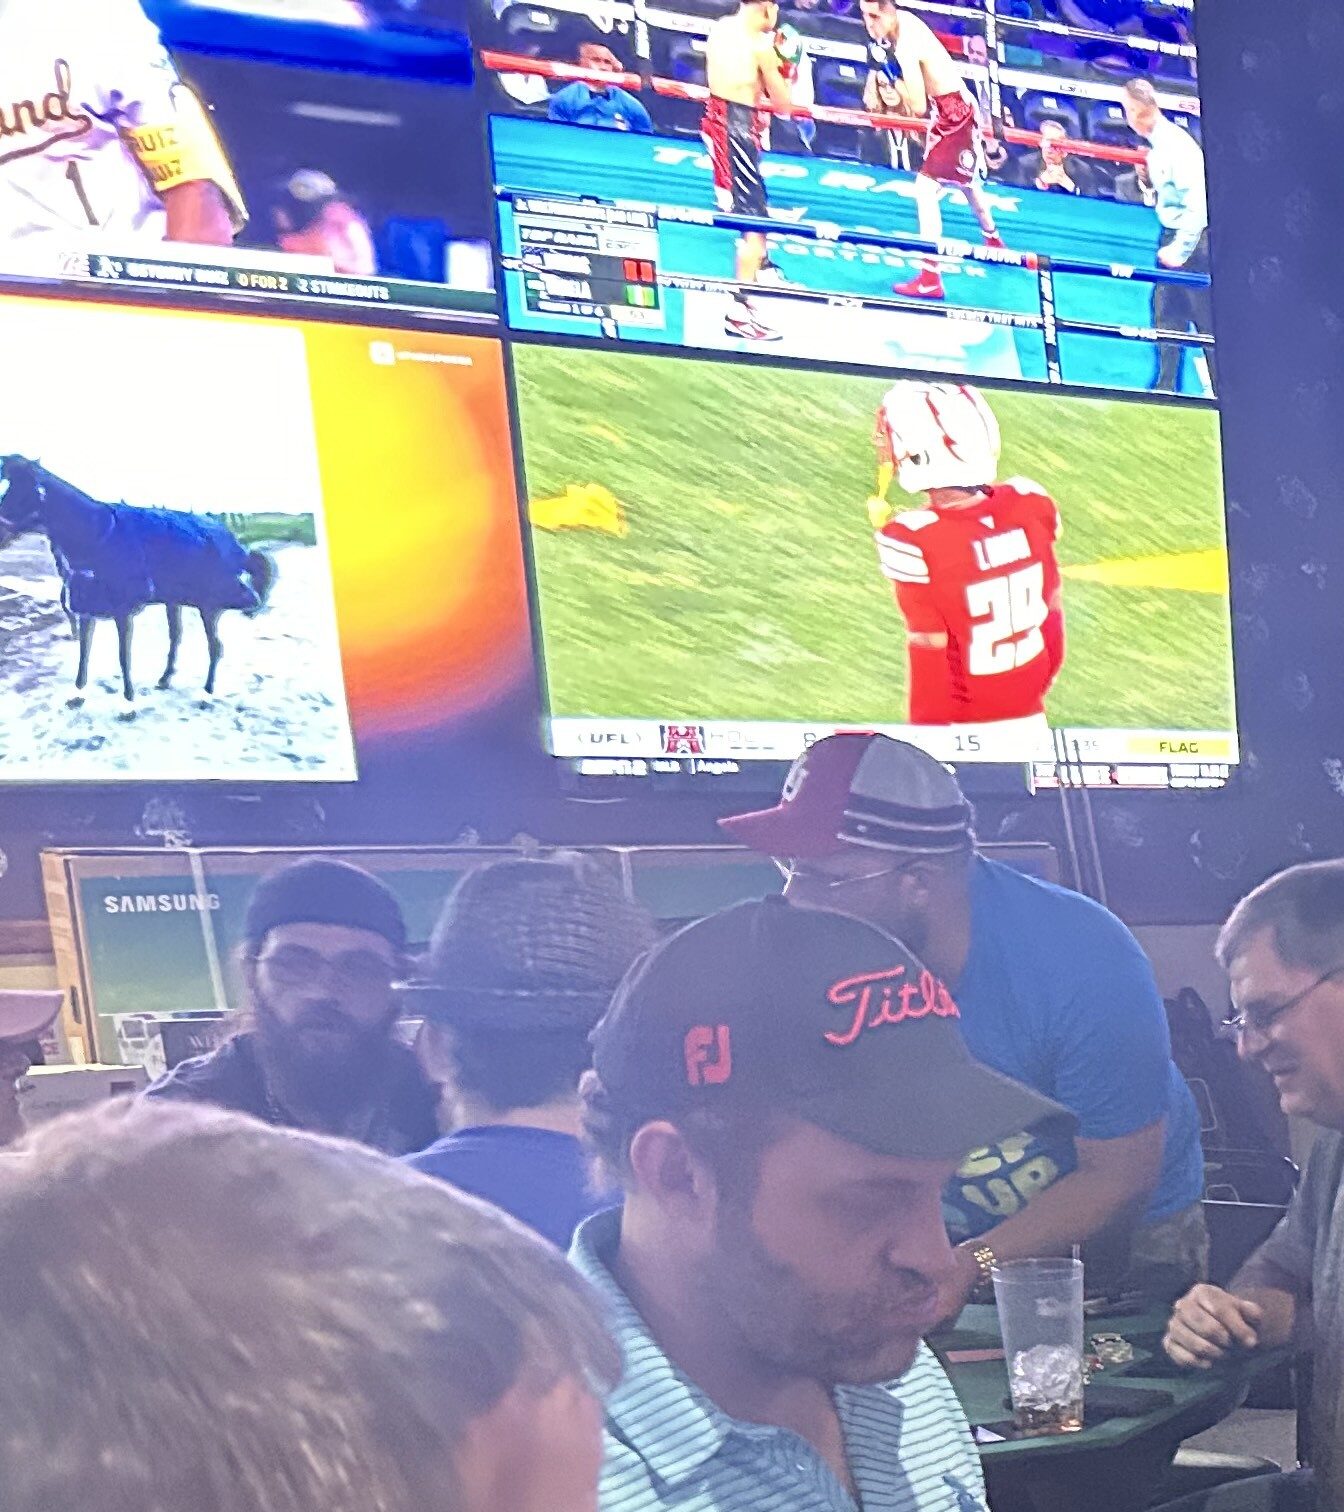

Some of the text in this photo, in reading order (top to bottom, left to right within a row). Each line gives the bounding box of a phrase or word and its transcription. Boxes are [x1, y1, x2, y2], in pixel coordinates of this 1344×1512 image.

[250, 273, 277, 290] FOR
[277, 276, 289, 291] 2
[954, 734, 982, 752] 15
[1159, 741, 1199, 754] FLAG
[104, 893, 221, 915] SAMSUNG
[684, 1024, 732, 1086] FJ
